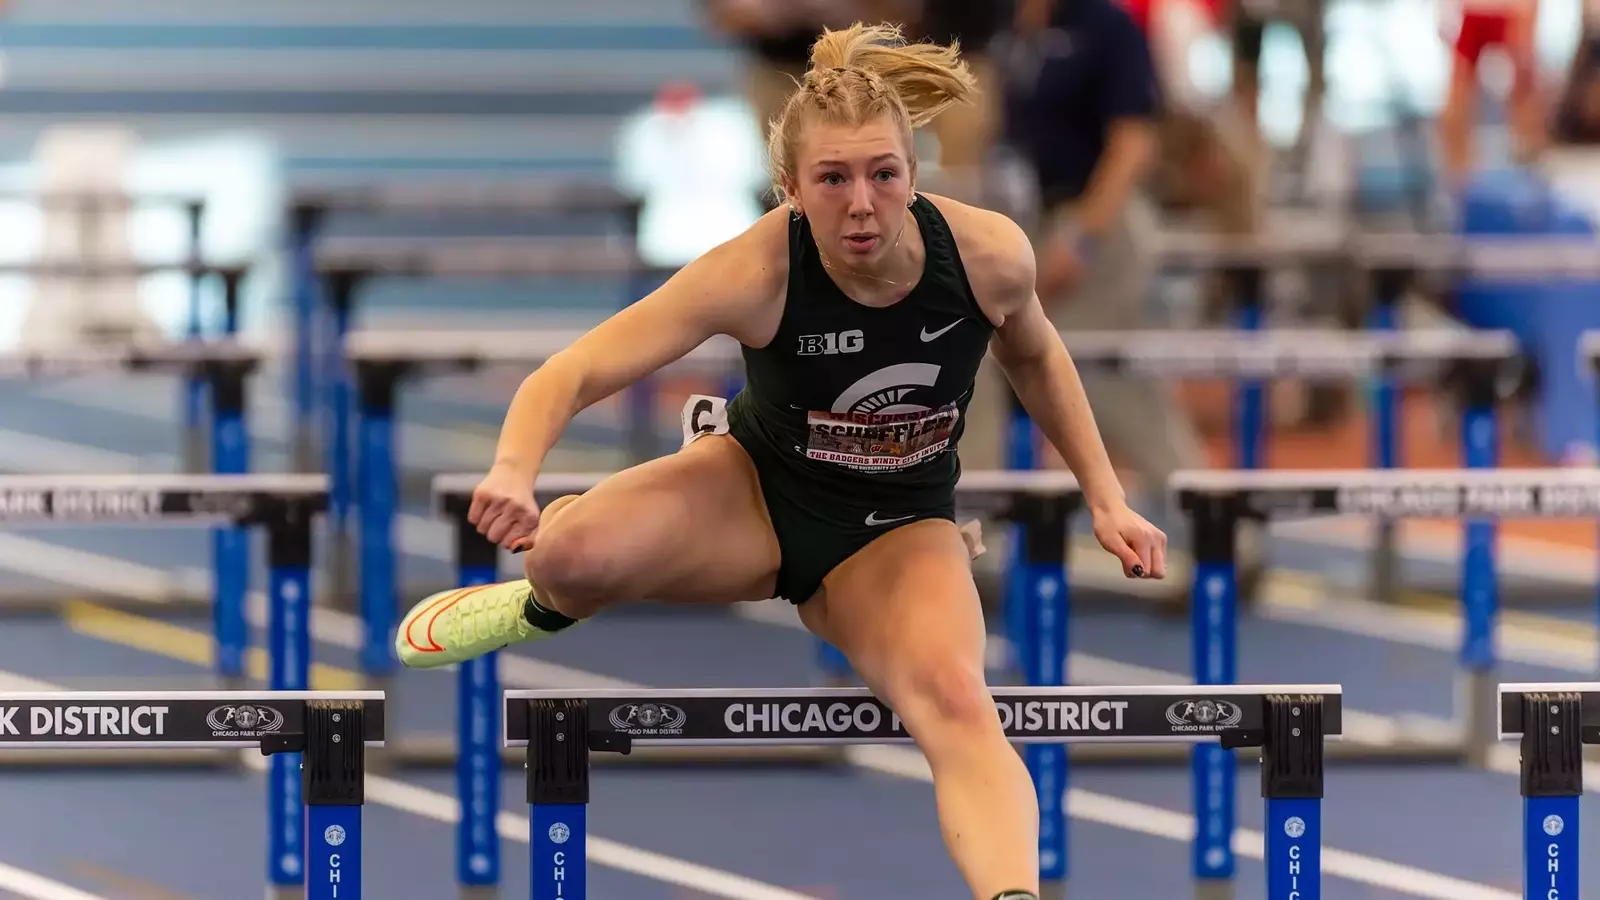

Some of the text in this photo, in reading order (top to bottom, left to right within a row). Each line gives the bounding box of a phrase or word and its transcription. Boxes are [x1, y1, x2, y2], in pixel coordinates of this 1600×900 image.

[809, 451, 828, 460] THE
[829, 454, 870, 465] BADGERS
[872, 457, 901, 465] WINDY
[902, 454, 920, 465] CITY
[921, 442, 946, 457] INVITE
[30, 706, 169, 735] DISTRICT
[724, 703, 881, 732] CHICAGO
[553, 852, 565, 900] CHI
